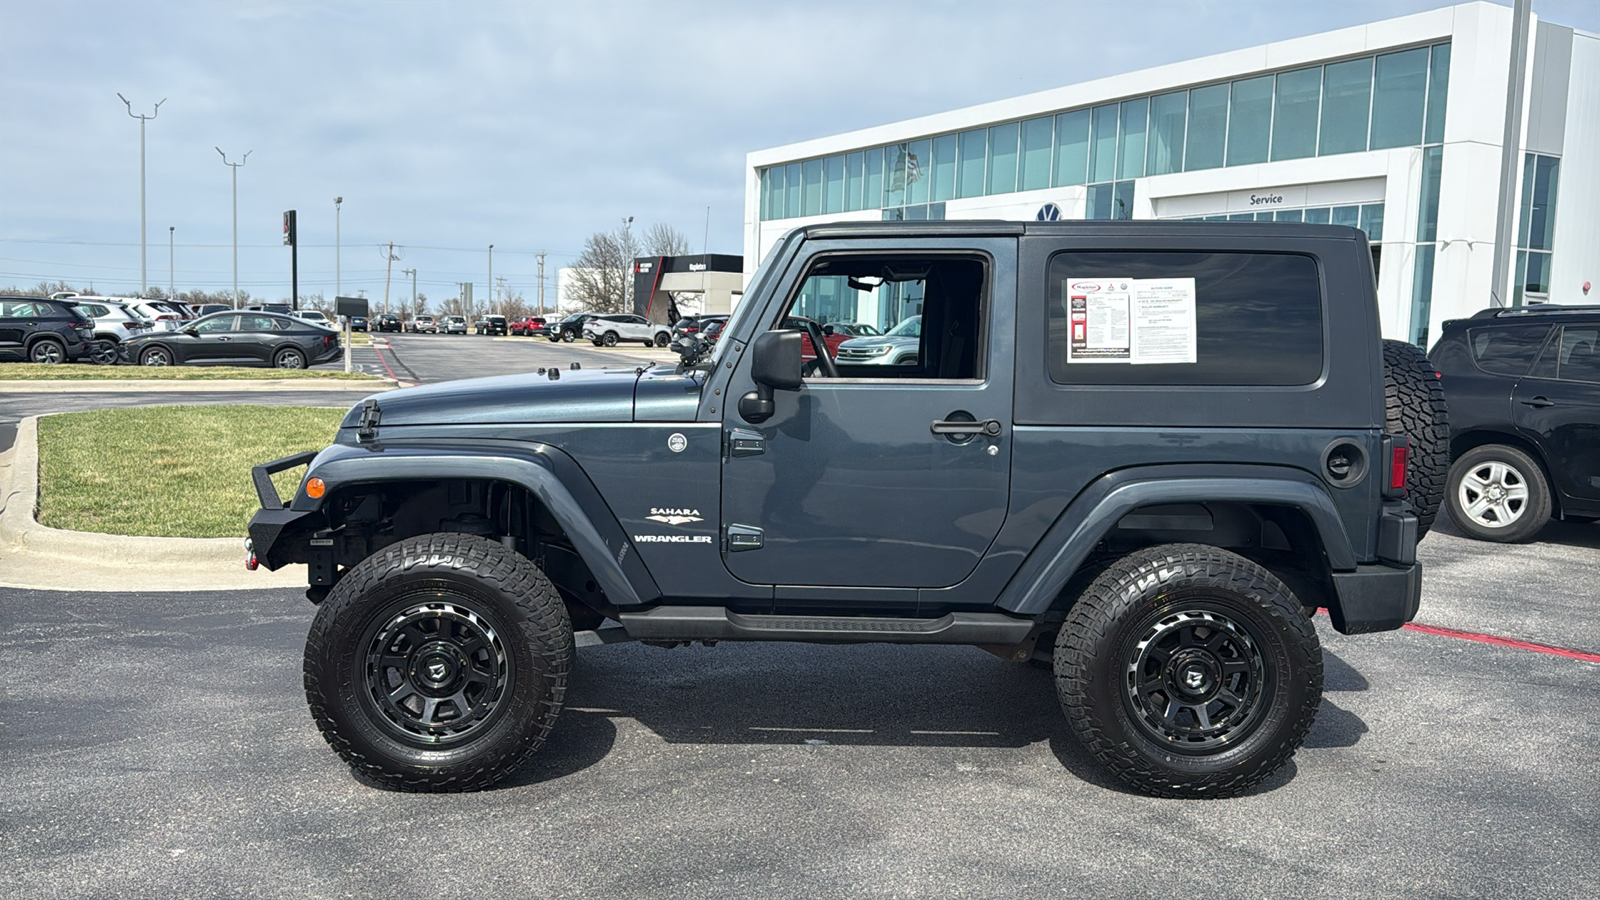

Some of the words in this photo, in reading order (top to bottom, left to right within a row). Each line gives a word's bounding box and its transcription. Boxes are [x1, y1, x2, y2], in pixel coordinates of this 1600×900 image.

[1250, 194, 1283, 205] Service
[650, 507, 700, 516] SAHARA
[634, 534, 713, 544] WRANGLER
